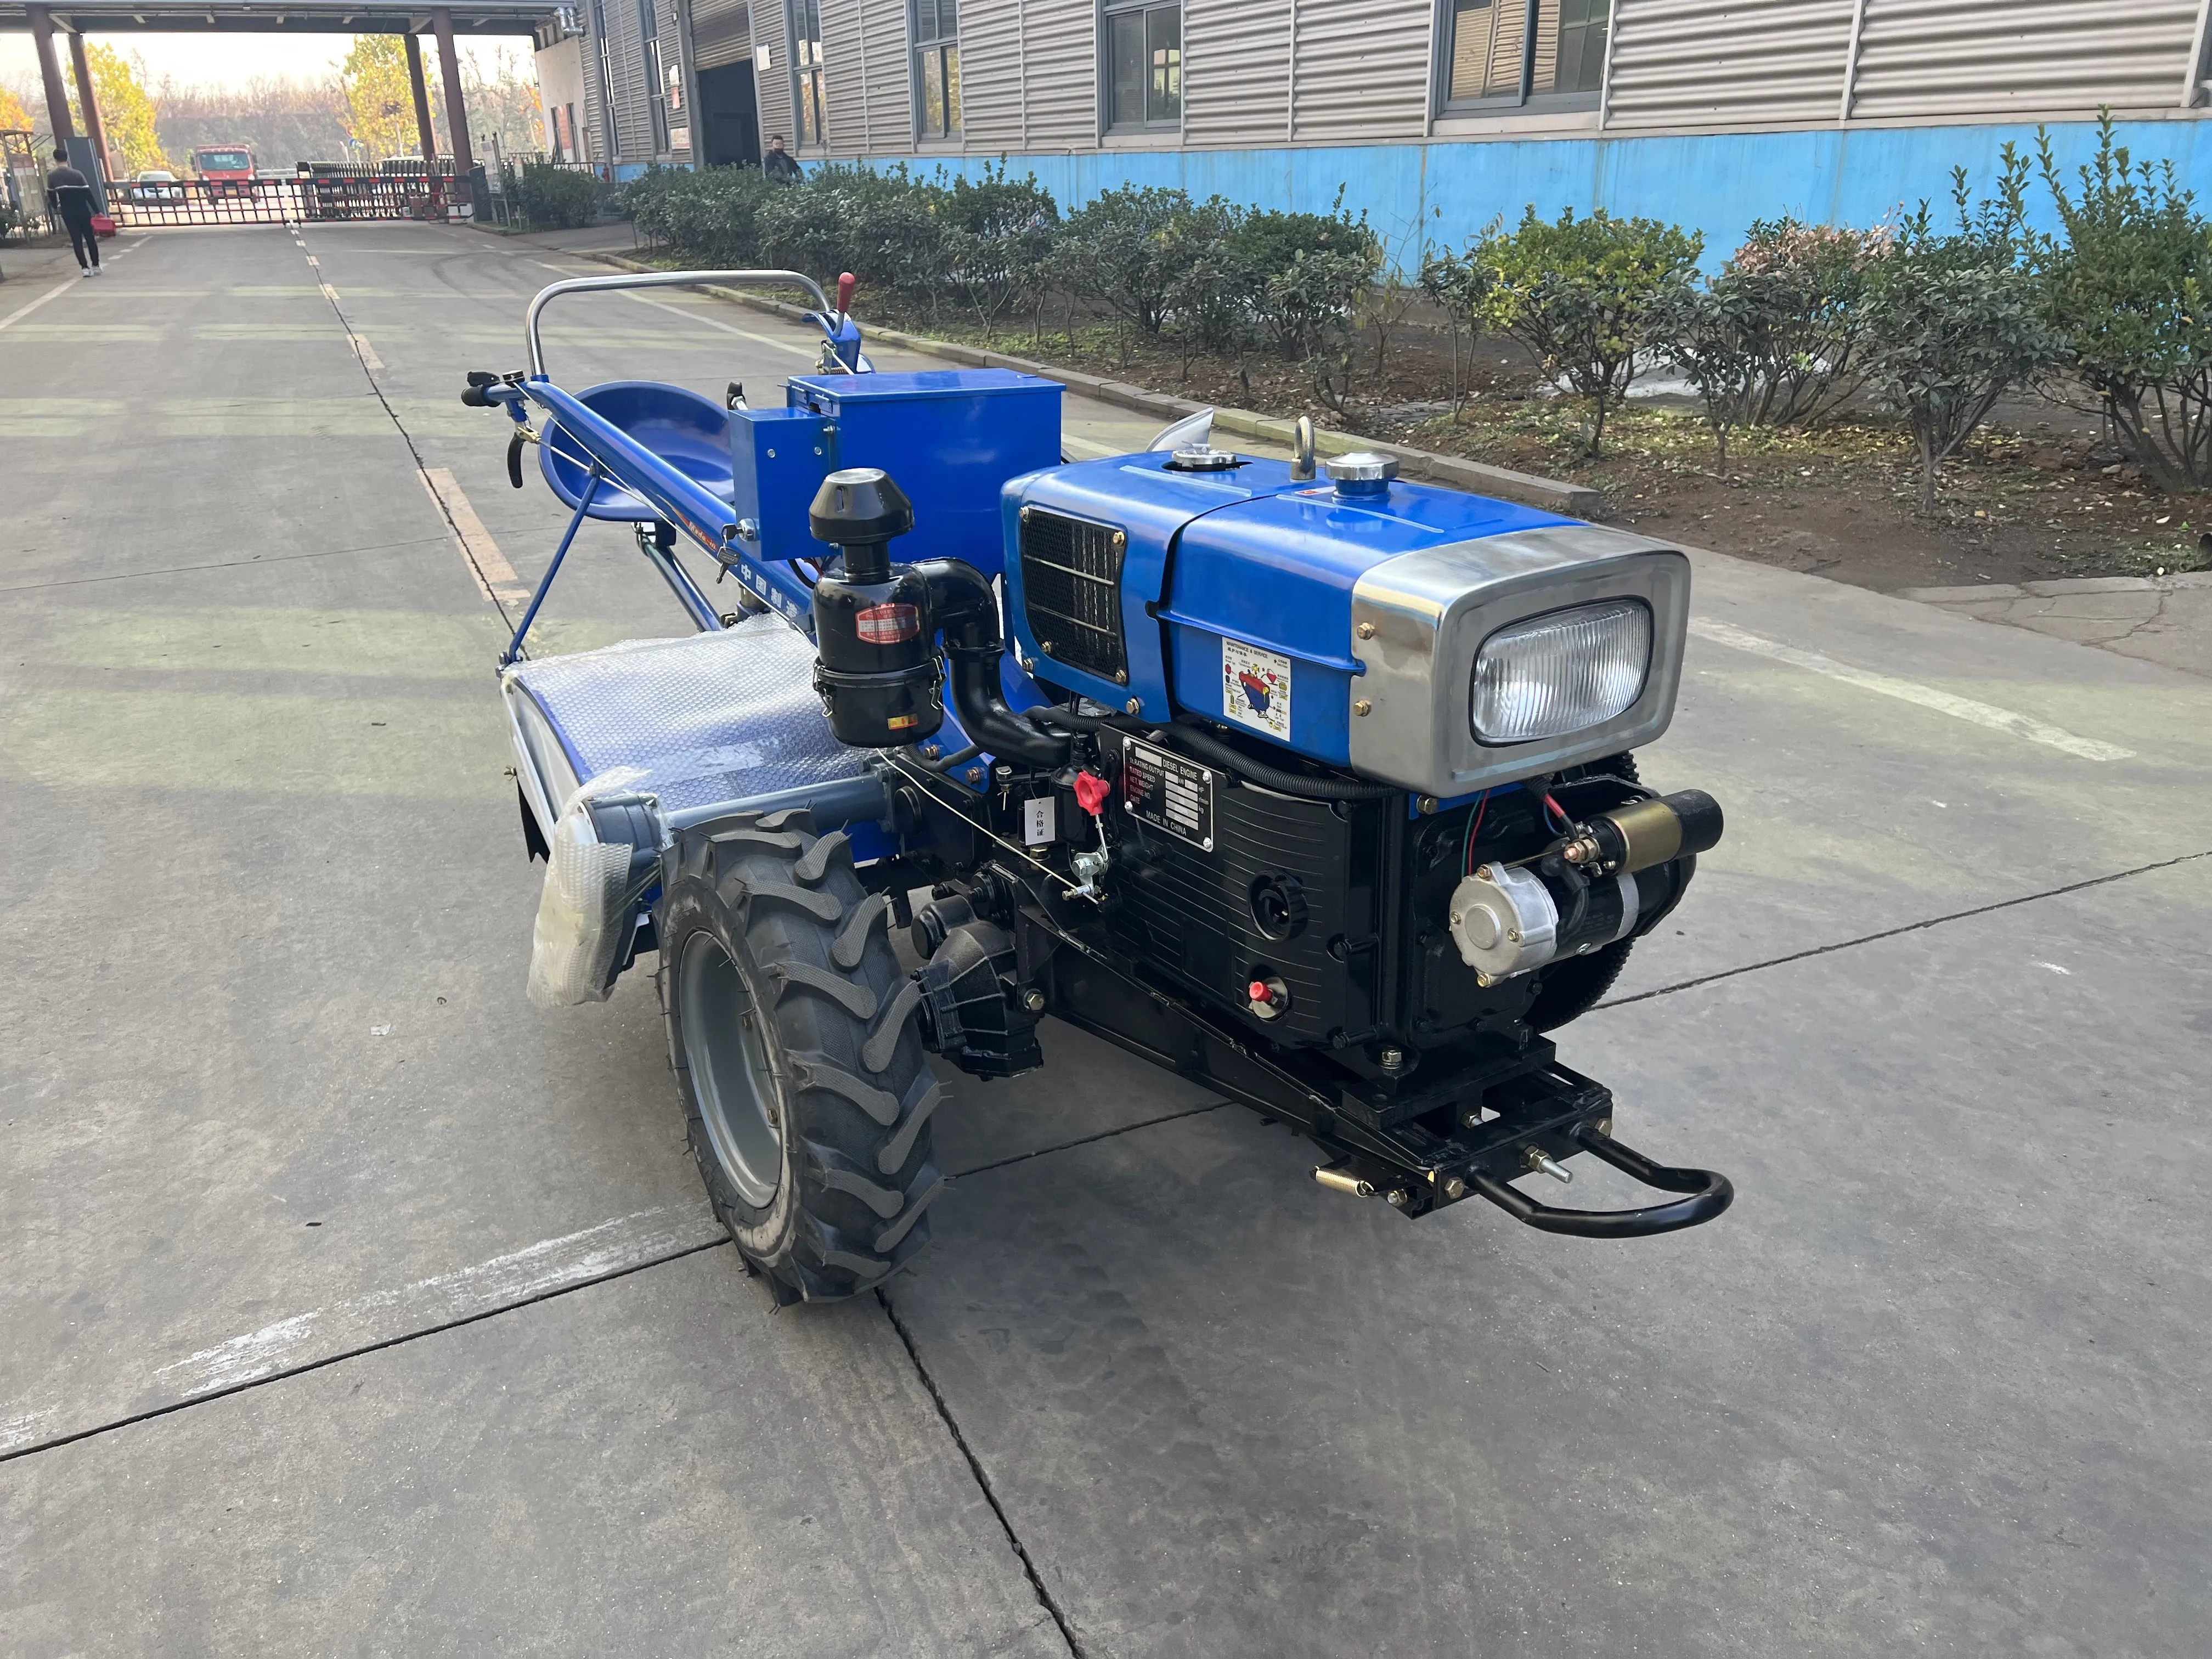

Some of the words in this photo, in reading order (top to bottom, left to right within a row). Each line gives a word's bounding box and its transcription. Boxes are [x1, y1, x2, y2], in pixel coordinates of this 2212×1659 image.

[741, 564, 798, 618] 中国制造
[1129, 765, 1142, 777] RATED
[1142, 771, 1155, 783] SPEED
[1149, 764, 1164, 777] OUTPUT
[1163, 759, 1178, 773] DIESEL
[1180, 766, 1197, 781] ENGINE
[1130, 793, 1140, 805] DATE
[1138, 778, 1153, 791] WEIGHT
[1198, 805, 1204, 815] kg
[1036, 810, 1045, 836] 合格证
[1146, 809, 1160, 824] MADE
[1163, 817, 1167, 827] IN
[1170, 820, 1186, 837] CHINA
